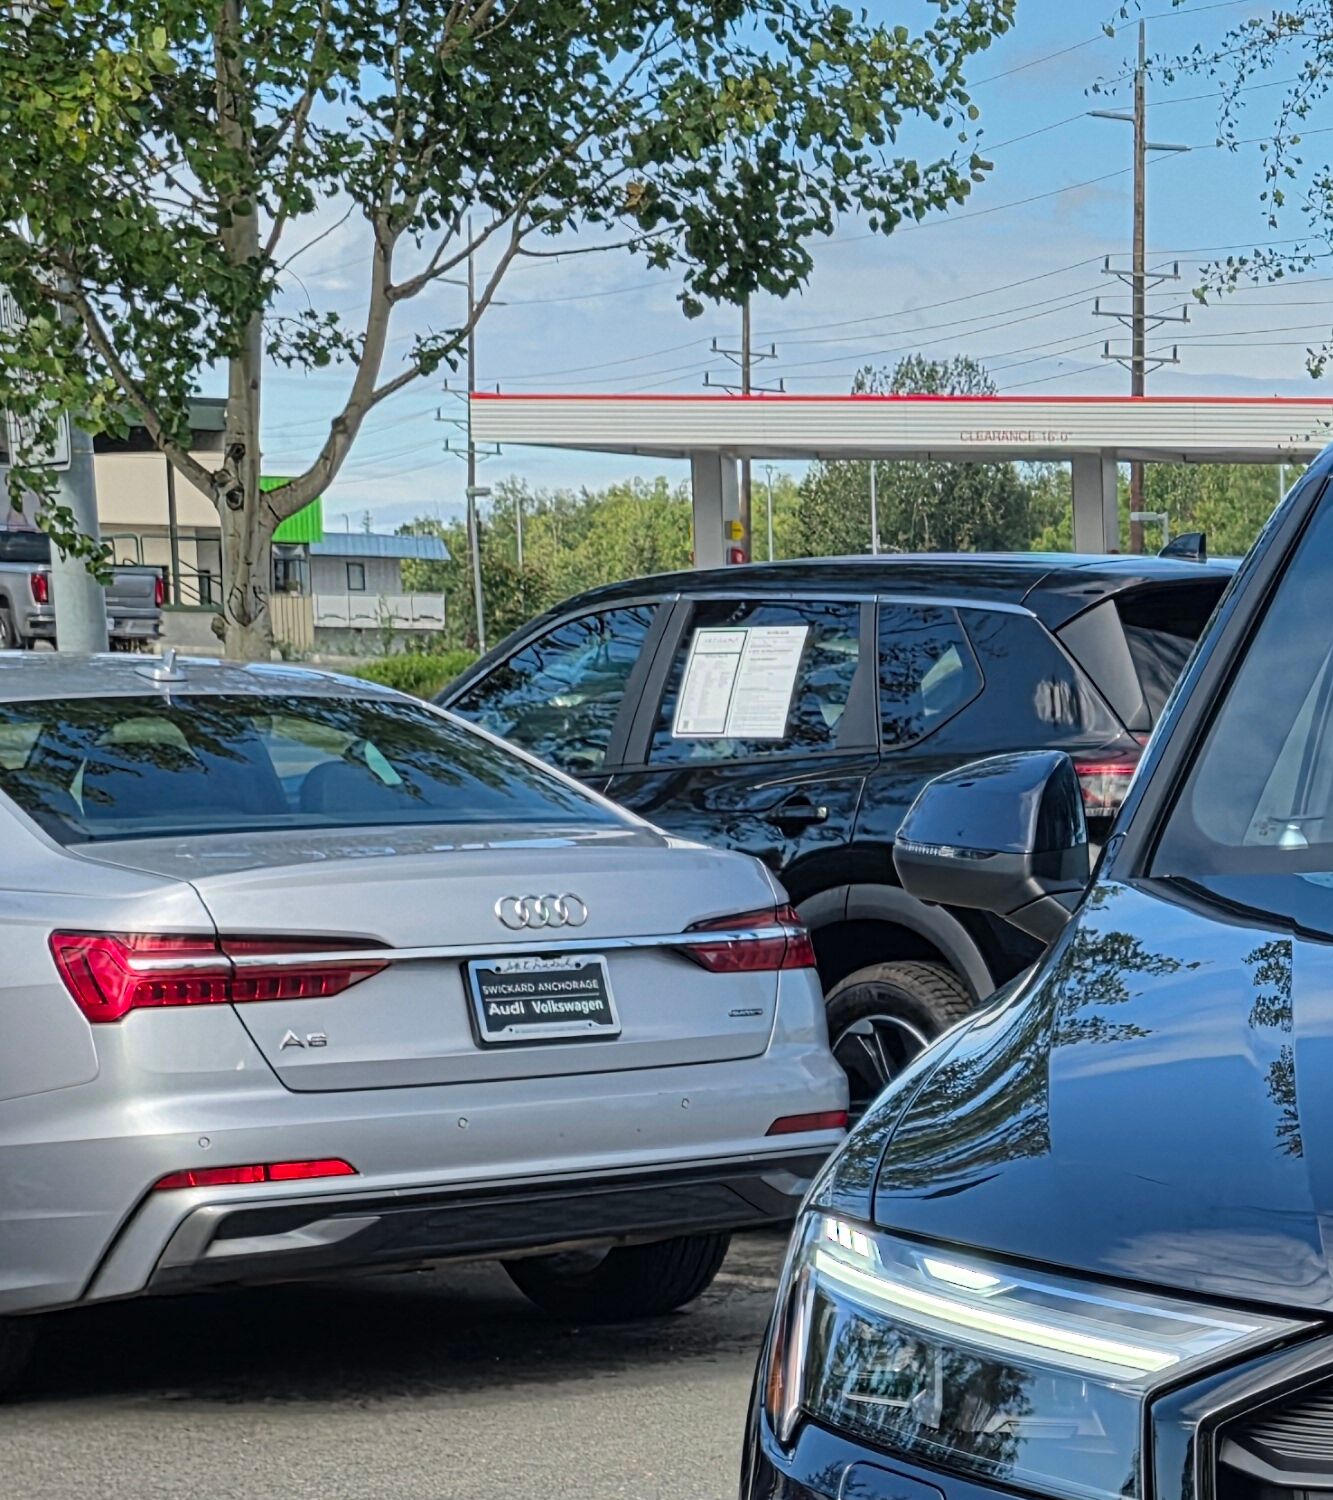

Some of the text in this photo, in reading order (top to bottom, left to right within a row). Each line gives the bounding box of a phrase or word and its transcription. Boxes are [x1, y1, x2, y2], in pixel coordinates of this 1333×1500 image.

[960, 430, 1036, 442] CLEARANCE
[482, 979, 600, 995] SWICKARD ANCHORAGE
[488, 1000, 604, 1016] Audi Volkswagen
[279, 1029, 328, 1050] A6
